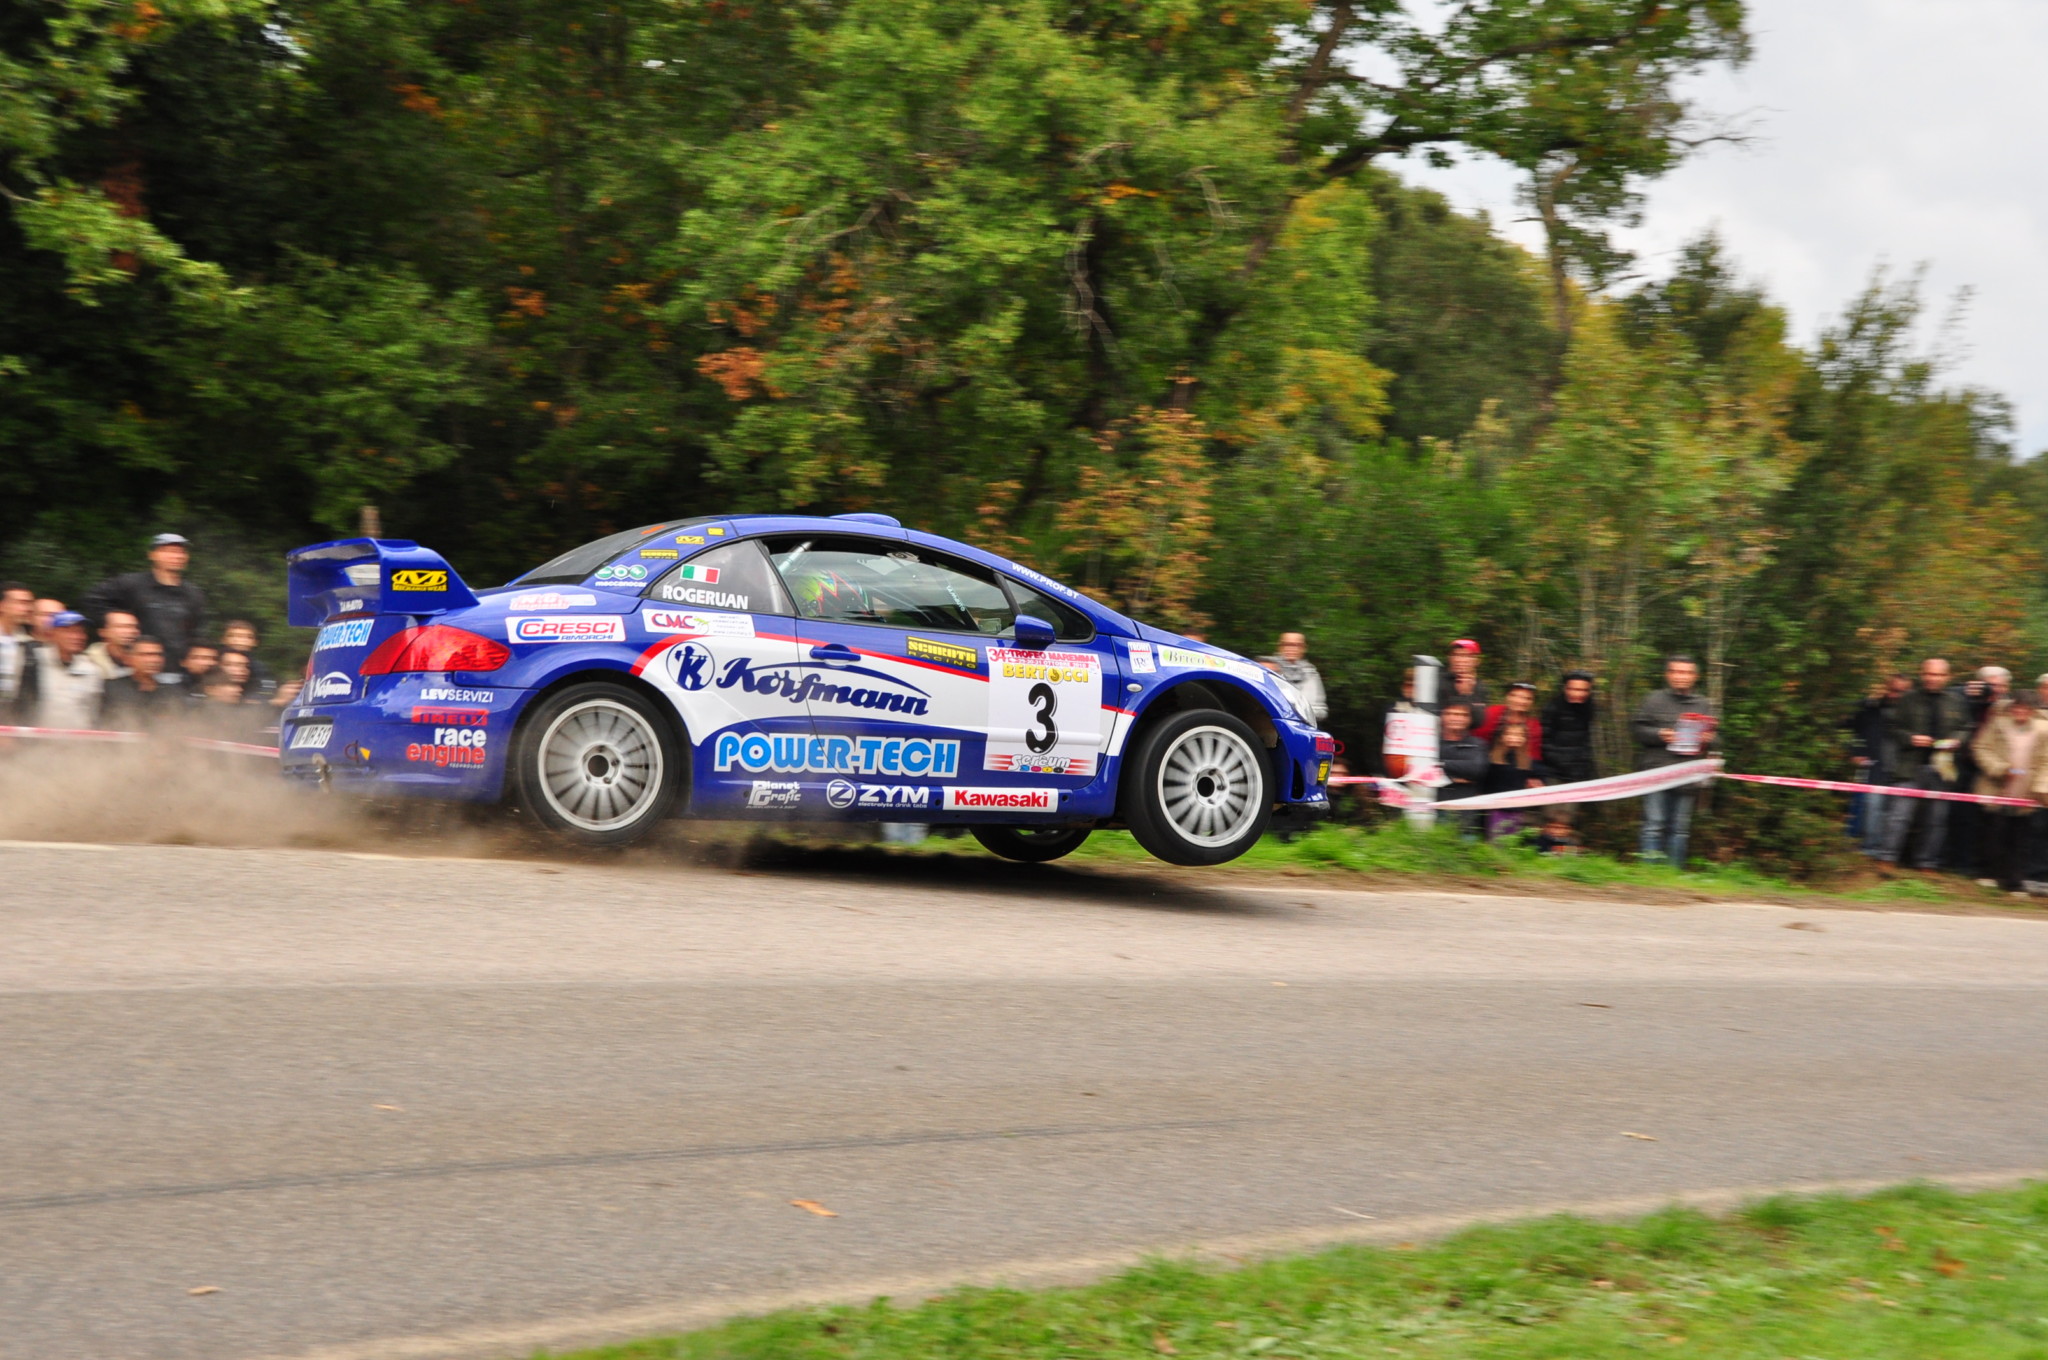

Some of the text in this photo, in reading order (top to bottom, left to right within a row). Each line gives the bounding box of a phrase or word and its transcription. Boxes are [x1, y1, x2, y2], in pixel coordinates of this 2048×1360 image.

[662, 585, 748, 610] ROGERUAN
[522, 622, 616, 634] CRESCI
[651, 613, 695, 629] CMC
[315, 619, 375, 652] POWER-TECH
[908, 641, 977, 663] SCHROTH
[908, 651, 977, 669] RACING
[1008, 649, 1047, 660] TROFEO
[1048, 651, 1097, 663] MAREMMA
[411, 706, 490, 726] PIRELLI
[1025, 682, 1059, 756] 3
[434, 727, 487, 747] race
[406, 743, 486, 768] engine
[714, 732, 960, 778] POWER-TECH
[748, 781, 800, 805] Planet
[860, 785, 930, 804] ZYM
[954, 789, 1048, 808] Kawasaki
